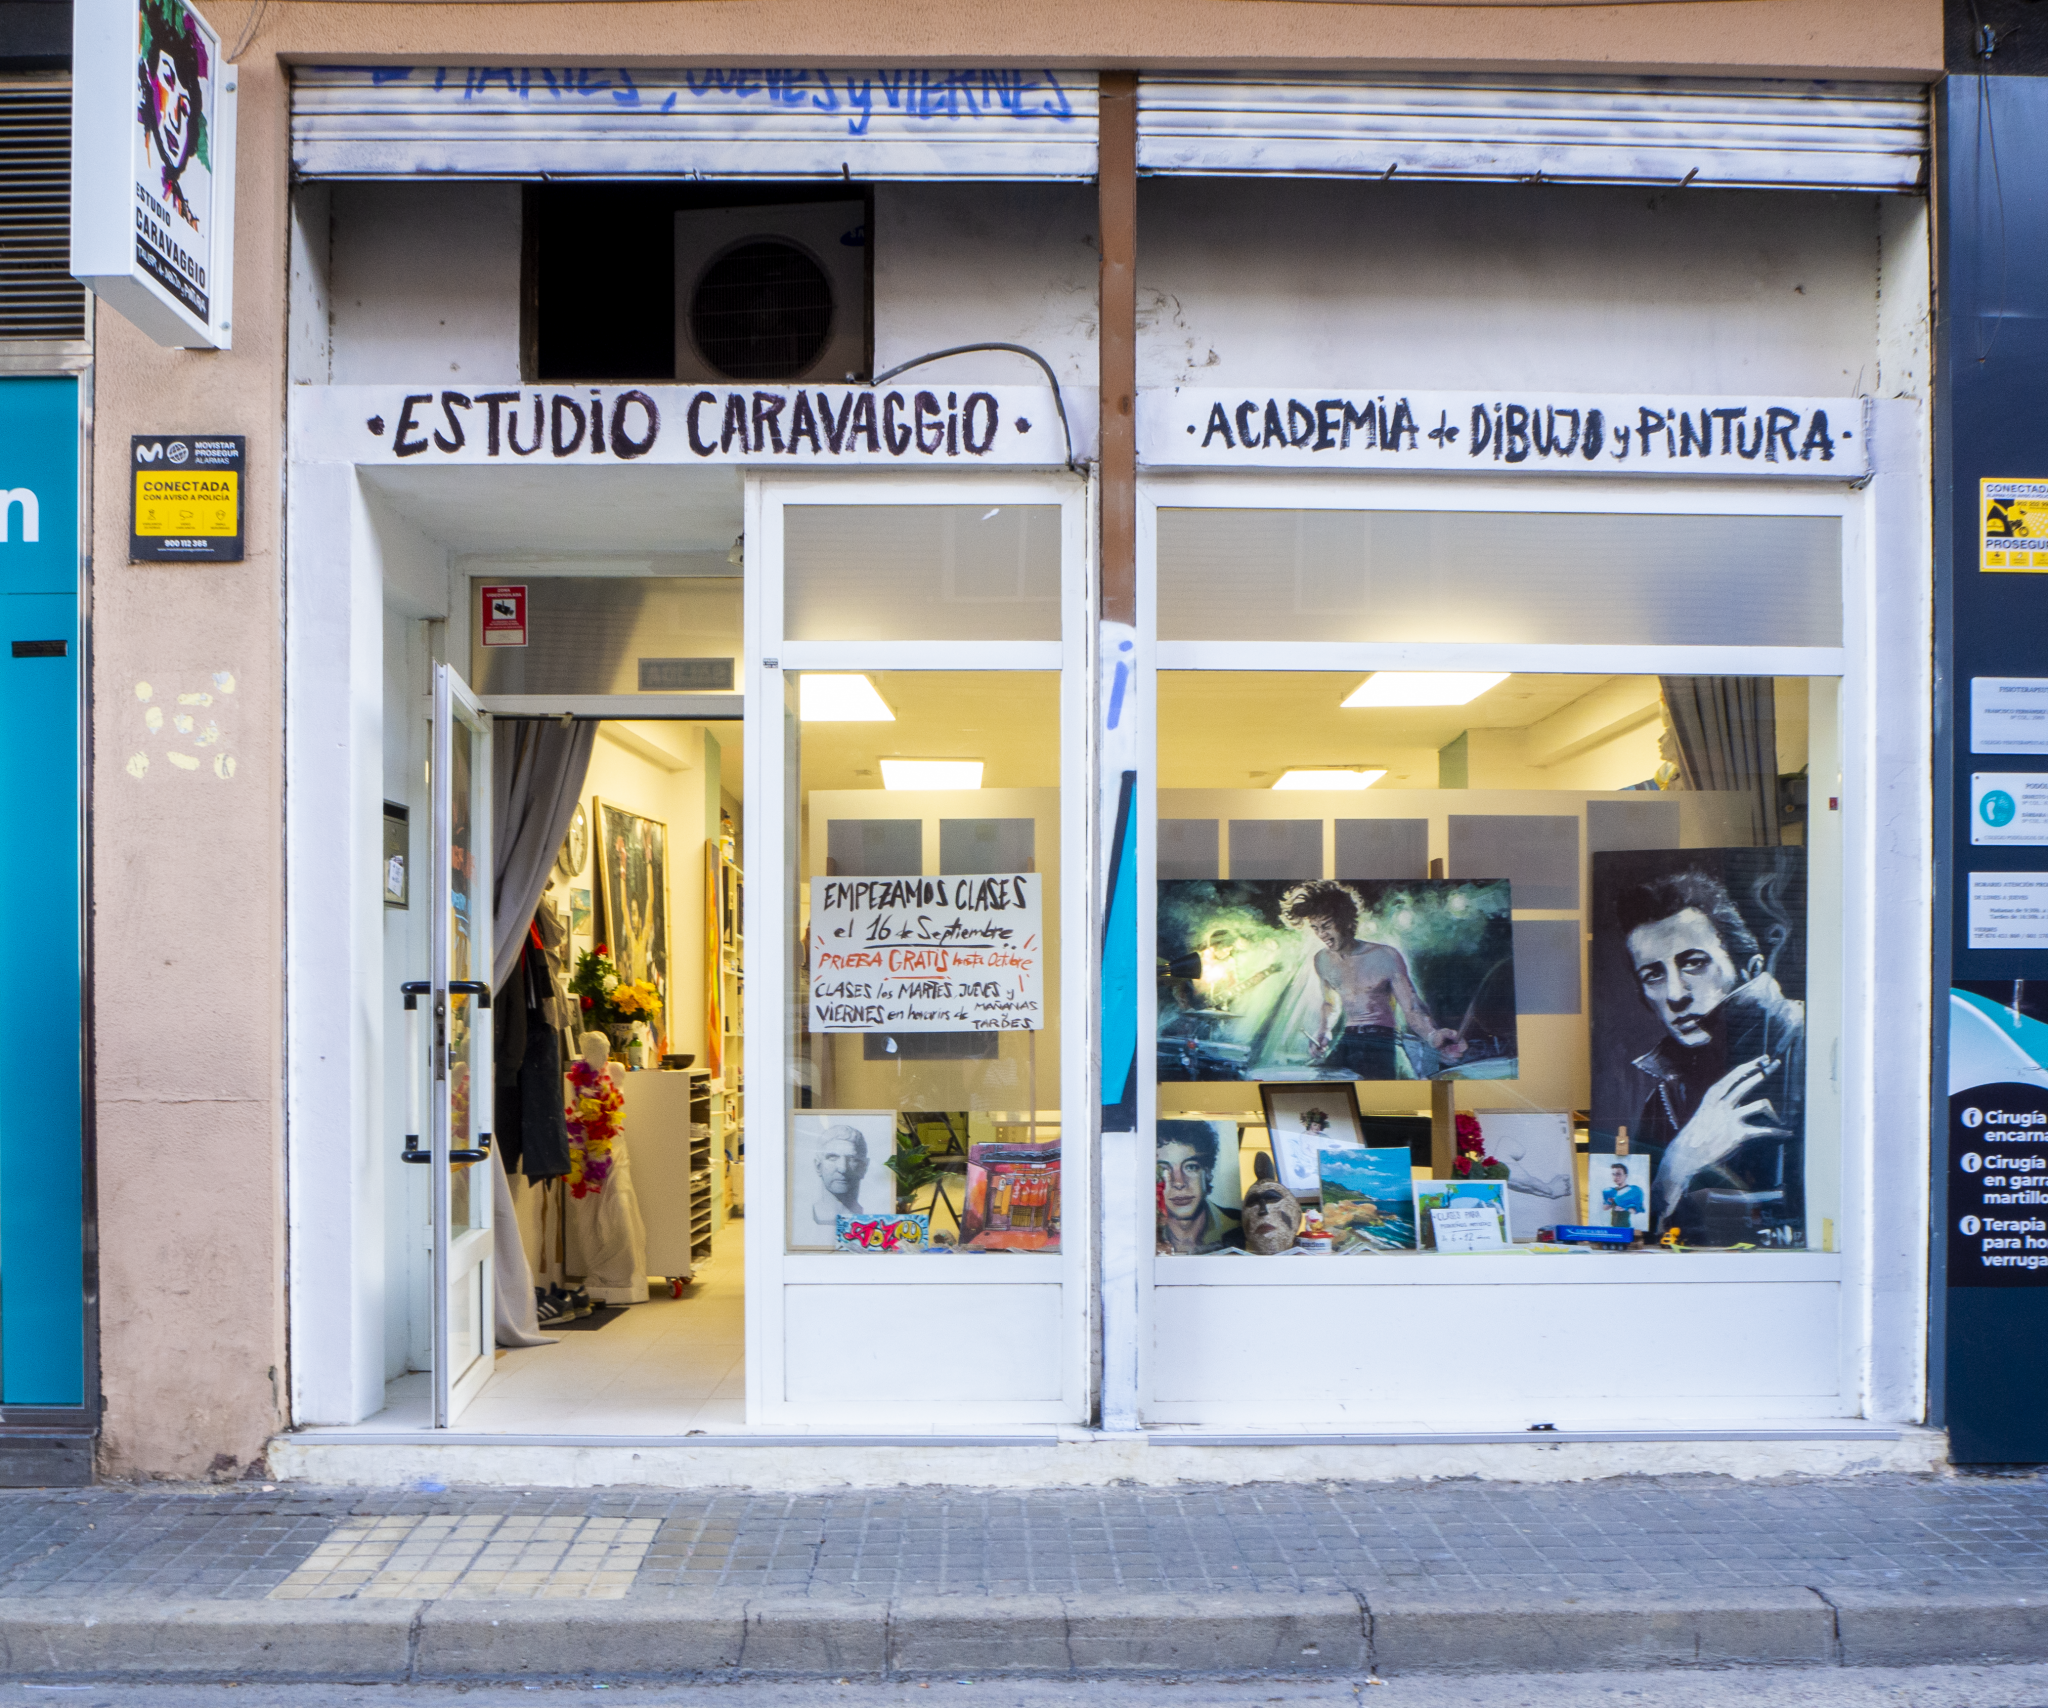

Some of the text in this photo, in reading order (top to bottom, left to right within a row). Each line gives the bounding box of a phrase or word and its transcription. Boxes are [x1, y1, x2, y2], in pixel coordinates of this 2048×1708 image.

[846, 76, 874, 135] y
[136, 181, 171, 227] ESTUDIO
[136, 205, 206, 289] CARAVAGGIO
[393, 387, 1000, 460] ESTUDIO CARAVAGGIO
[1201, 395, 1419, 452] ACADEMIA
[1468, 402, 1602, 463] DIBUJO
[1610, 423, 1632, 463] y
[1637, 404, 1835, 463] PINTURA
[195, 449, 239, 457] PROSEGUR
[195, 457, 230, 465] ALARMAS
[143, 481, 230, 492] CONECTADA
[1986, 483, 2048, 494] CONECTAD
[197, 492, 230, 501] POLICÍA
[164, 539, 180, 548] 900
[180, 539, 192, 548] 112
[1986, 540, 2048, 549] PROSEGU
[824, 875, 1027, 911] EMPEZAMOS CLASES
[833, 918, 854, 938] el
[866, 914, 893, 941] 16
[916, 915, 1014, 946] Septiembre
[818, 951, 883, 970] PRUEBA
[888, 949, 949, 972] GRATIS
[814, 981, 872, 1000] CLASES
[877, 981, 893, 999] los
[959, 981, 1002, 998] JUEVES
[1006, 987, 1015, 1000] y
[815, 1002, 884, 1024] VIERNES
[887, 1011, 904, 1020] en
[974, 999, 1038, 1011] MAÑANAS
[971, 1017, 1035, 1030] TARDES
[1984, 1109, 2047, 1127] Cirugía
[1983, 1154, 2046, 1172] Cirugía
[1983, 1176, 2006, 1187] en
[1982, 1190, 2048, 1204] martillo
[1982, 1216, 2046, 1234] Terapia
[1981, 1234, 2048, 1251] para ho
[1980, 1255, 2048, 1270] verruga
